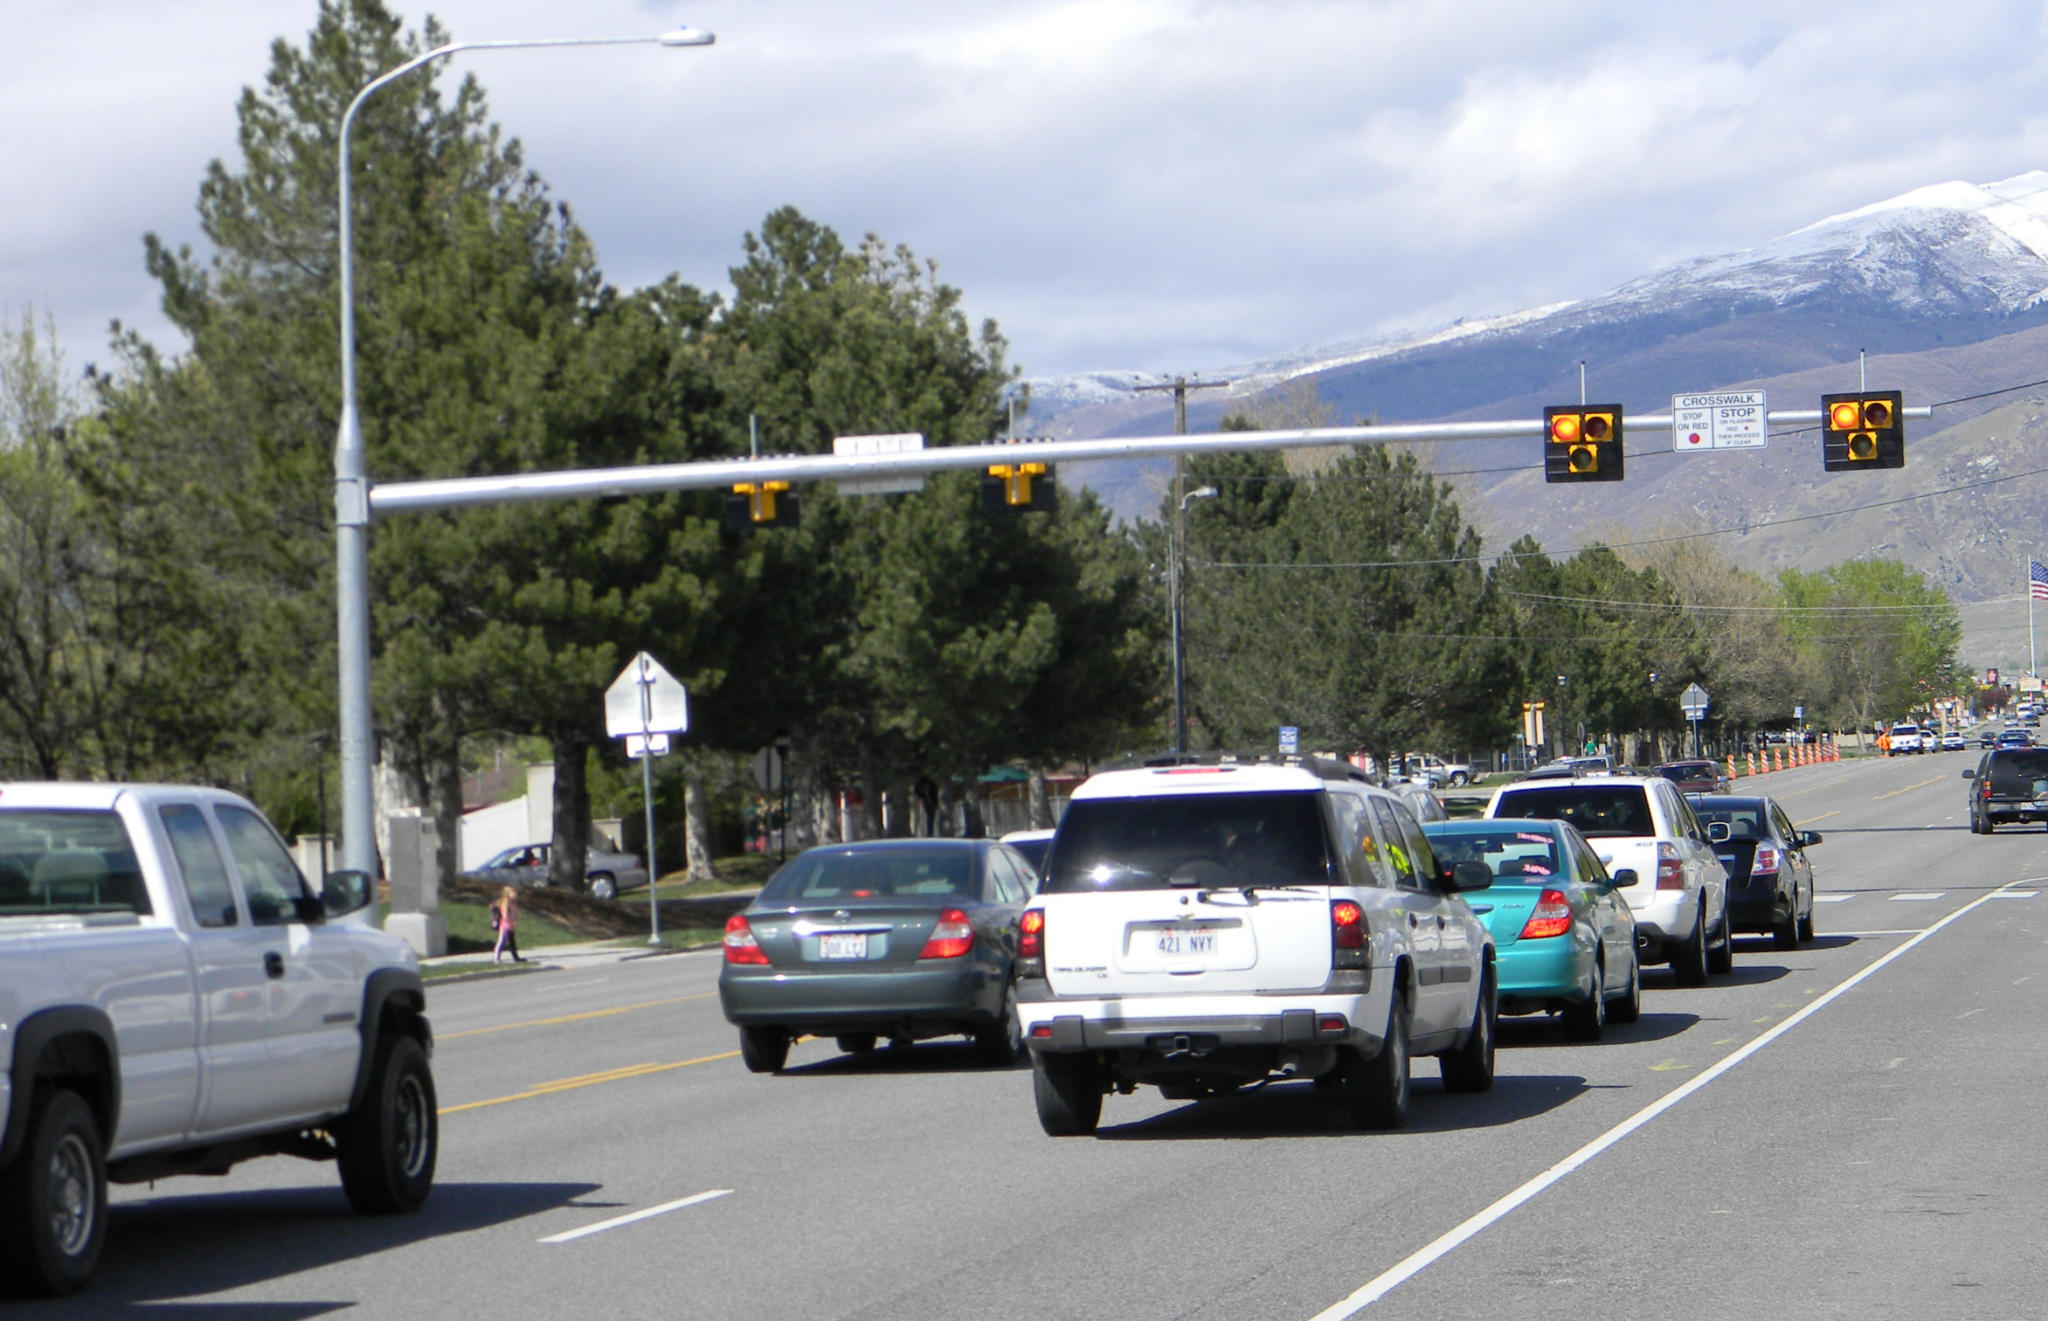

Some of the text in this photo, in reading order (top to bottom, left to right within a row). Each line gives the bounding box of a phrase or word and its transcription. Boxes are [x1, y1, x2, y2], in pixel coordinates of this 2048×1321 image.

[1683, 394, 1754, 406] CROSSWALK
[1682, 412, 1703, 420] STOP
[1720, 408, 1755, 418] STOP
[1677, 422, 1708, 431] ON RED
[1159, 936, 1213, 953] 421 NVY
